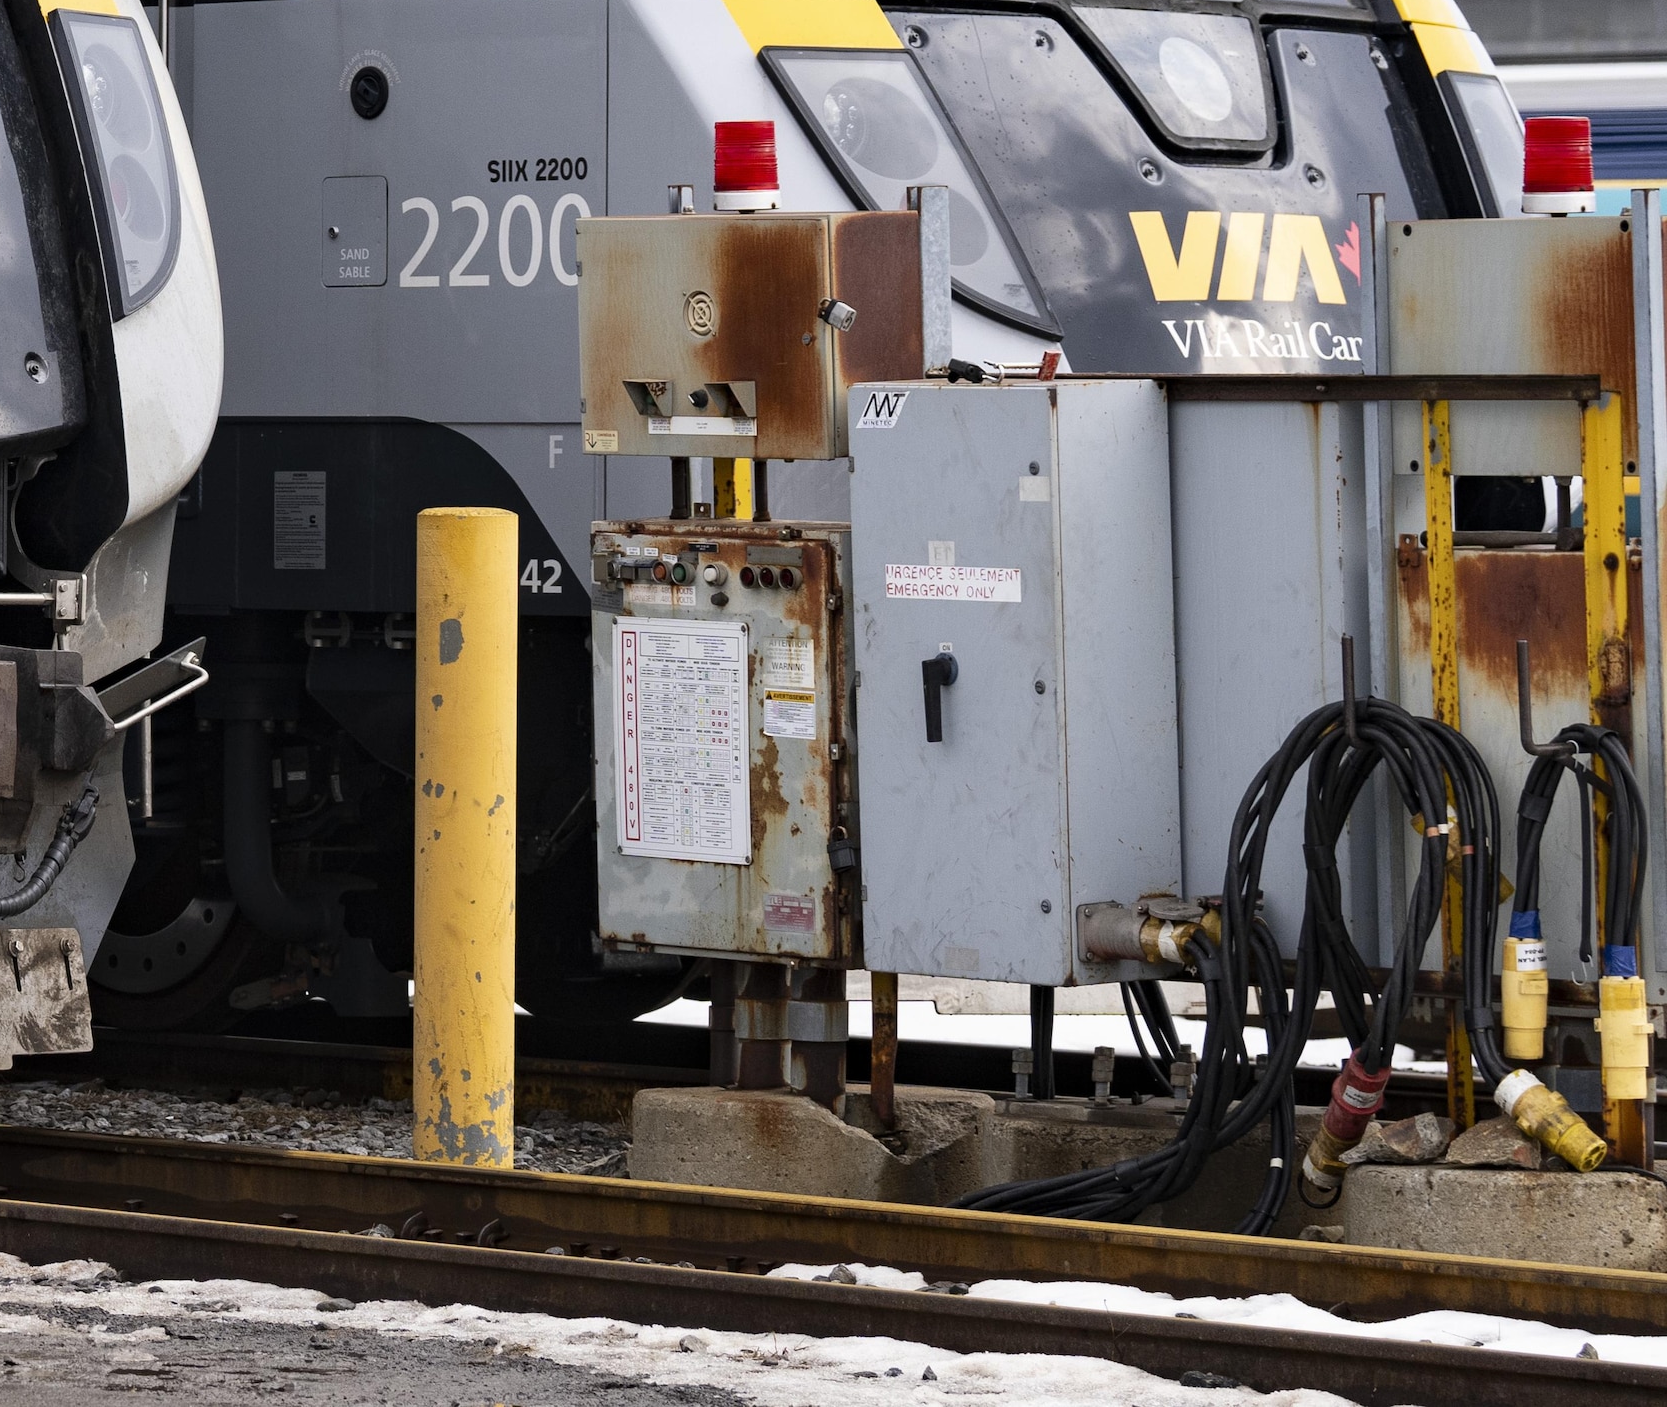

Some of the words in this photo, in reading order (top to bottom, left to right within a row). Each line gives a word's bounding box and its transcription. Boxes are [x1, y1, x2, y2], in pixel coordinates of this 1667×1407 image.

[488, 159, 529, 183] SIIX
[535, 157, 588, 181] 2200
[399, 192, 592, 288] 2200
[340, 247, 370, 261] SAND
[1129, 211, 1347, 305] VIA
[338, 266, 371, 279] SABLE
[1161, 319, 1241, 359] VIA
[1242, 319, 1310, 359] Rail
[549, 435, 563, 469] F
[886, 566, 943, 580] URGENCE
[949, 567, 1020, 582] SEULEMENT
[632, 594, 656, 603] DANGER
[676, 595, 694, 604] VOLTS
[676, 586, 694, 596] VOLTS
[886, 583, 959, 597] EMERGENCY
[967, 586, 995, 599] ONLY
[768, 639, 808, 649] ATTENTION
[772, 661, 806, 672] WARNING
[626, 638, 634, 738] DANGER
[773, 693, 812, 701] AVERTISSEMENT
